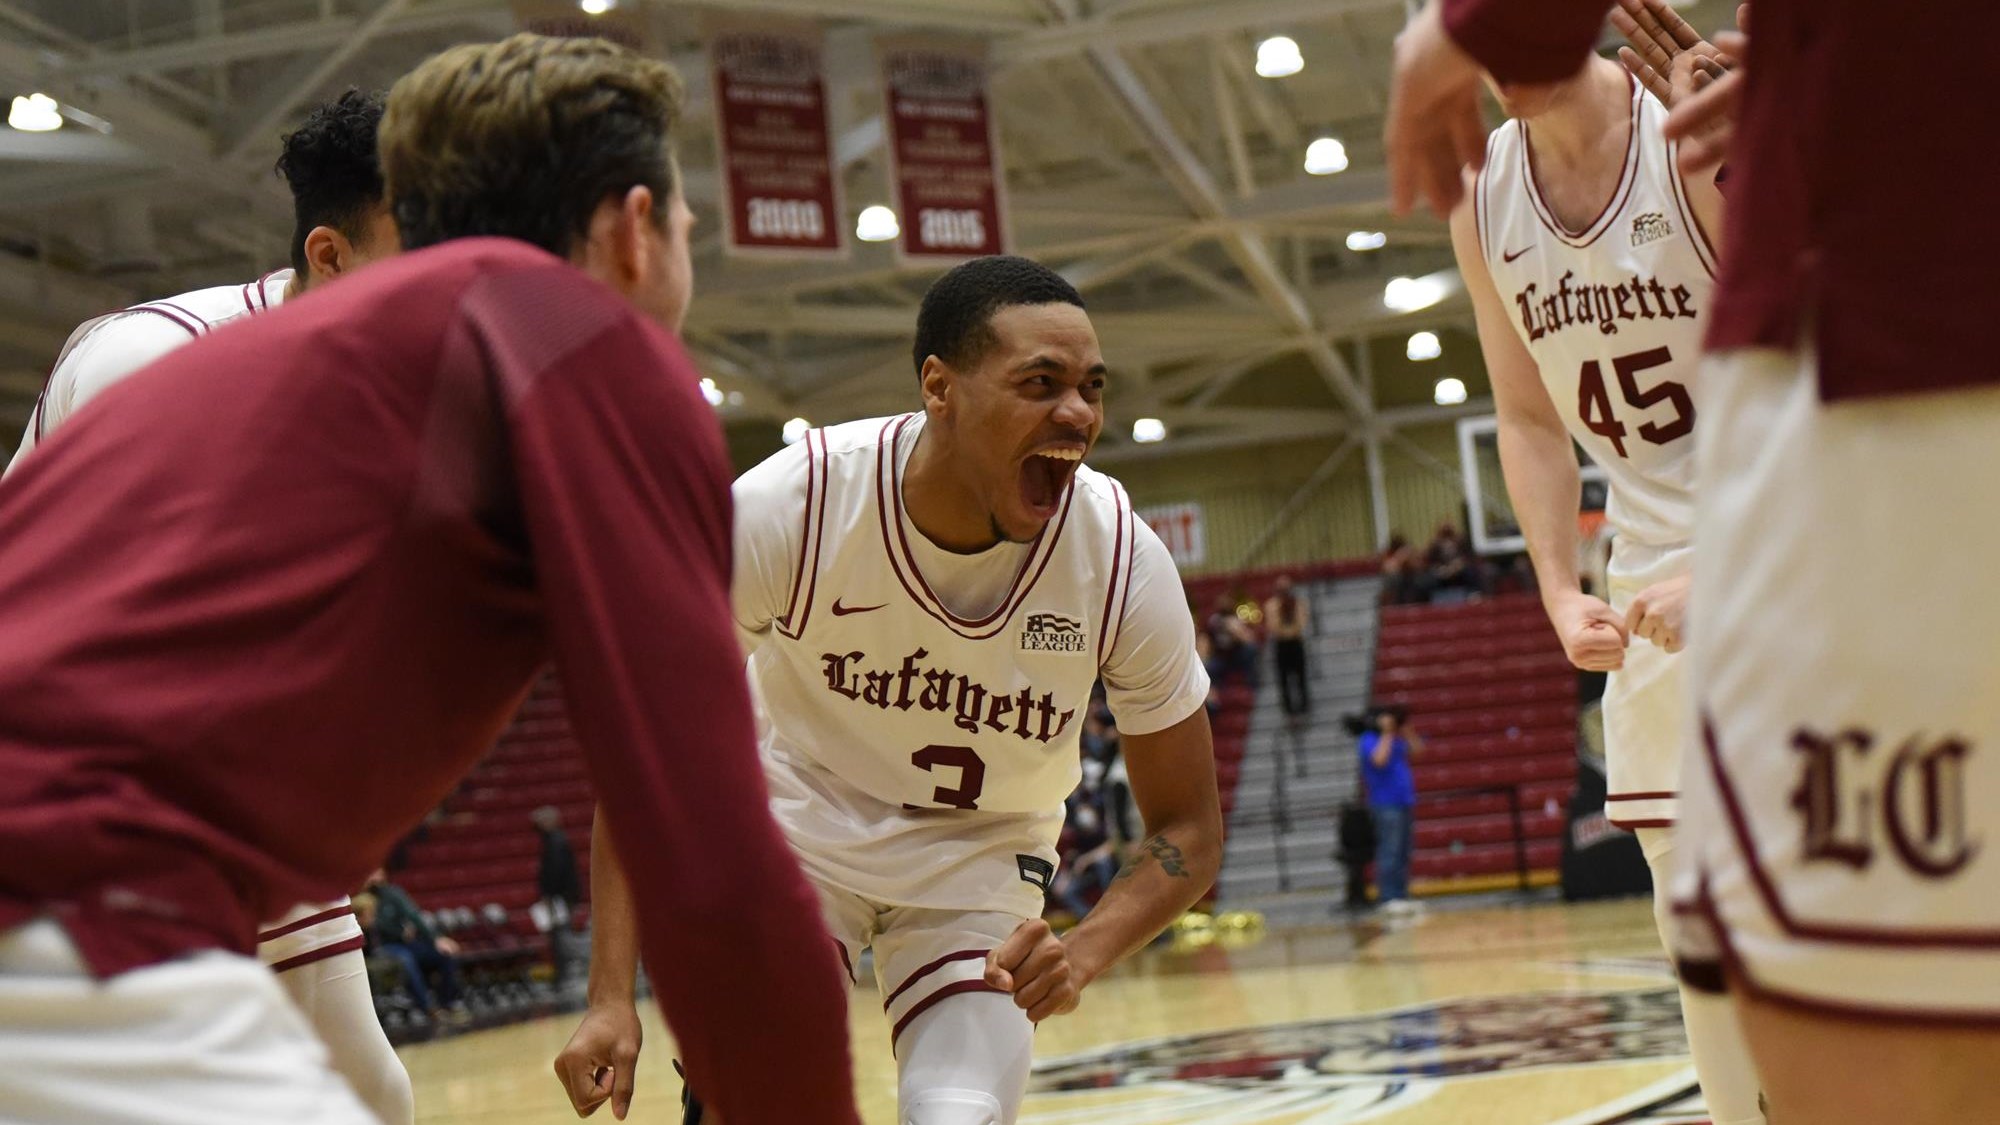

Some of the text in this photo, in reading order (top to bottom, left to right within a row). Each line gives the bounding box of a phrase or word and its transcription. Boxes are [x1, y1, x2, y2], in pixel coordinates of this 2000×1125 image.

[1516, 270, 1697, 342] Lafayette
[1578, 345, 1697, 459] 45
[1020, 641, 1086, 652] LEAGUE
[1021, 632, 1087, 643] PATRIOT
[902, 744, 986, 811] 3
[1788, 727, 1978, 880] LC
